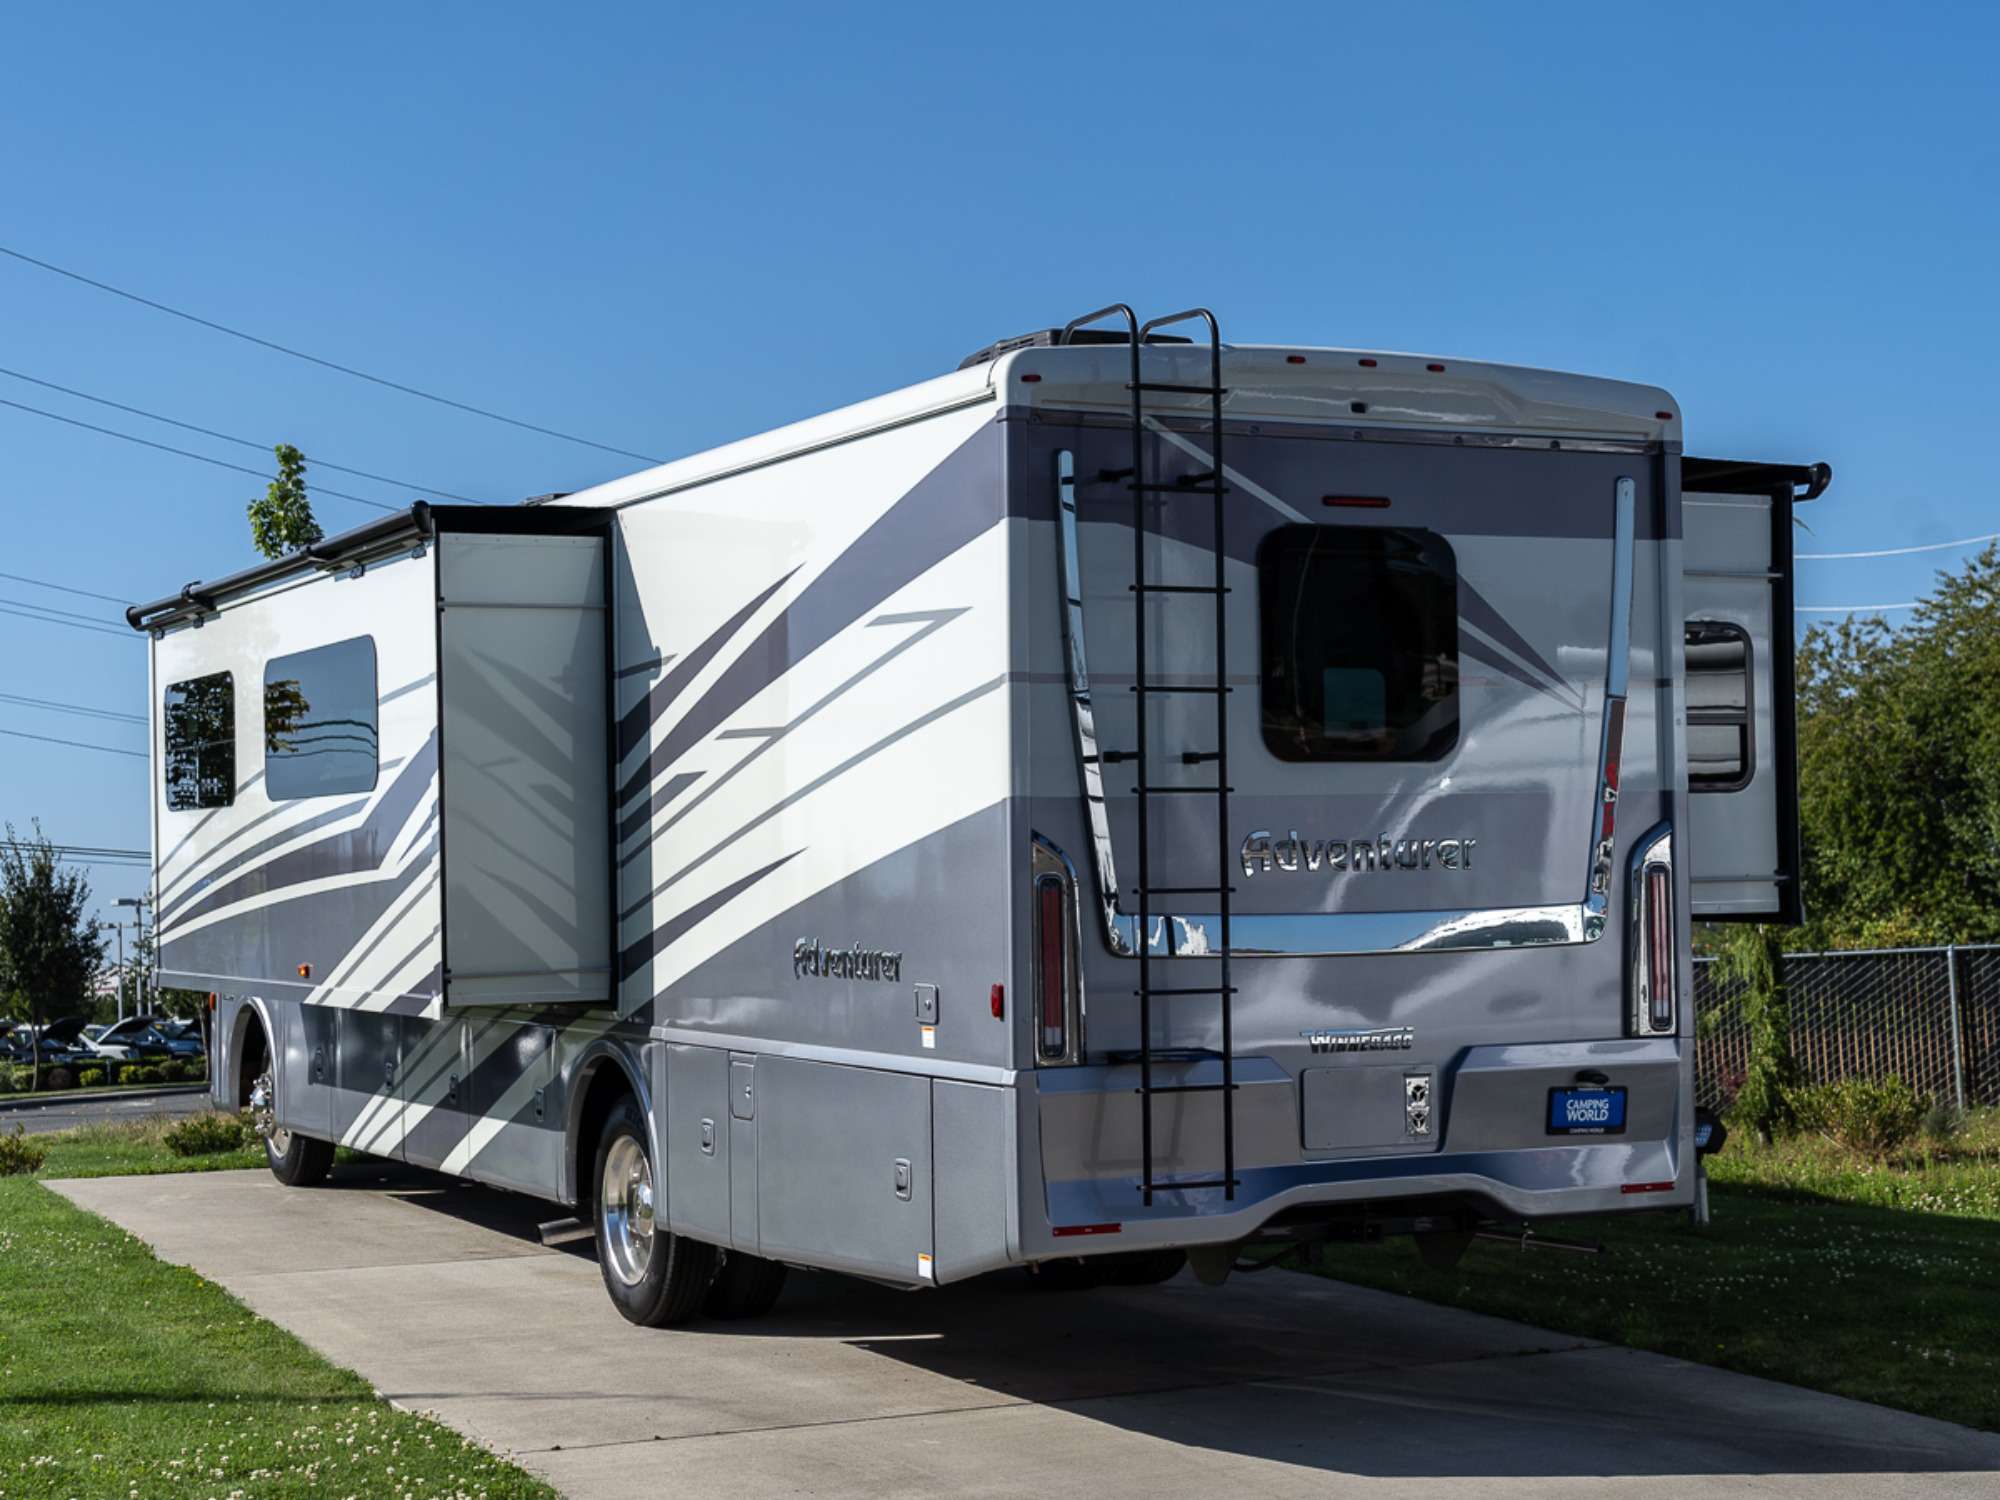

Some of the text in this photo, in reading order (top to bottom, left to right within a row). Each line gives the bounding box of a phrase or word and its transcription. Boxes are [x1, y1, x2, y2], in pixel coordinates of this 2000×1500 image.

[1241, 829, 1477, 878] Adventurer
[793, 936, 902, 981] Adventurer
[1566, 1098, 1609, 1109] CAMPING
[1566, 1109, 1609, 1122] WORLD
